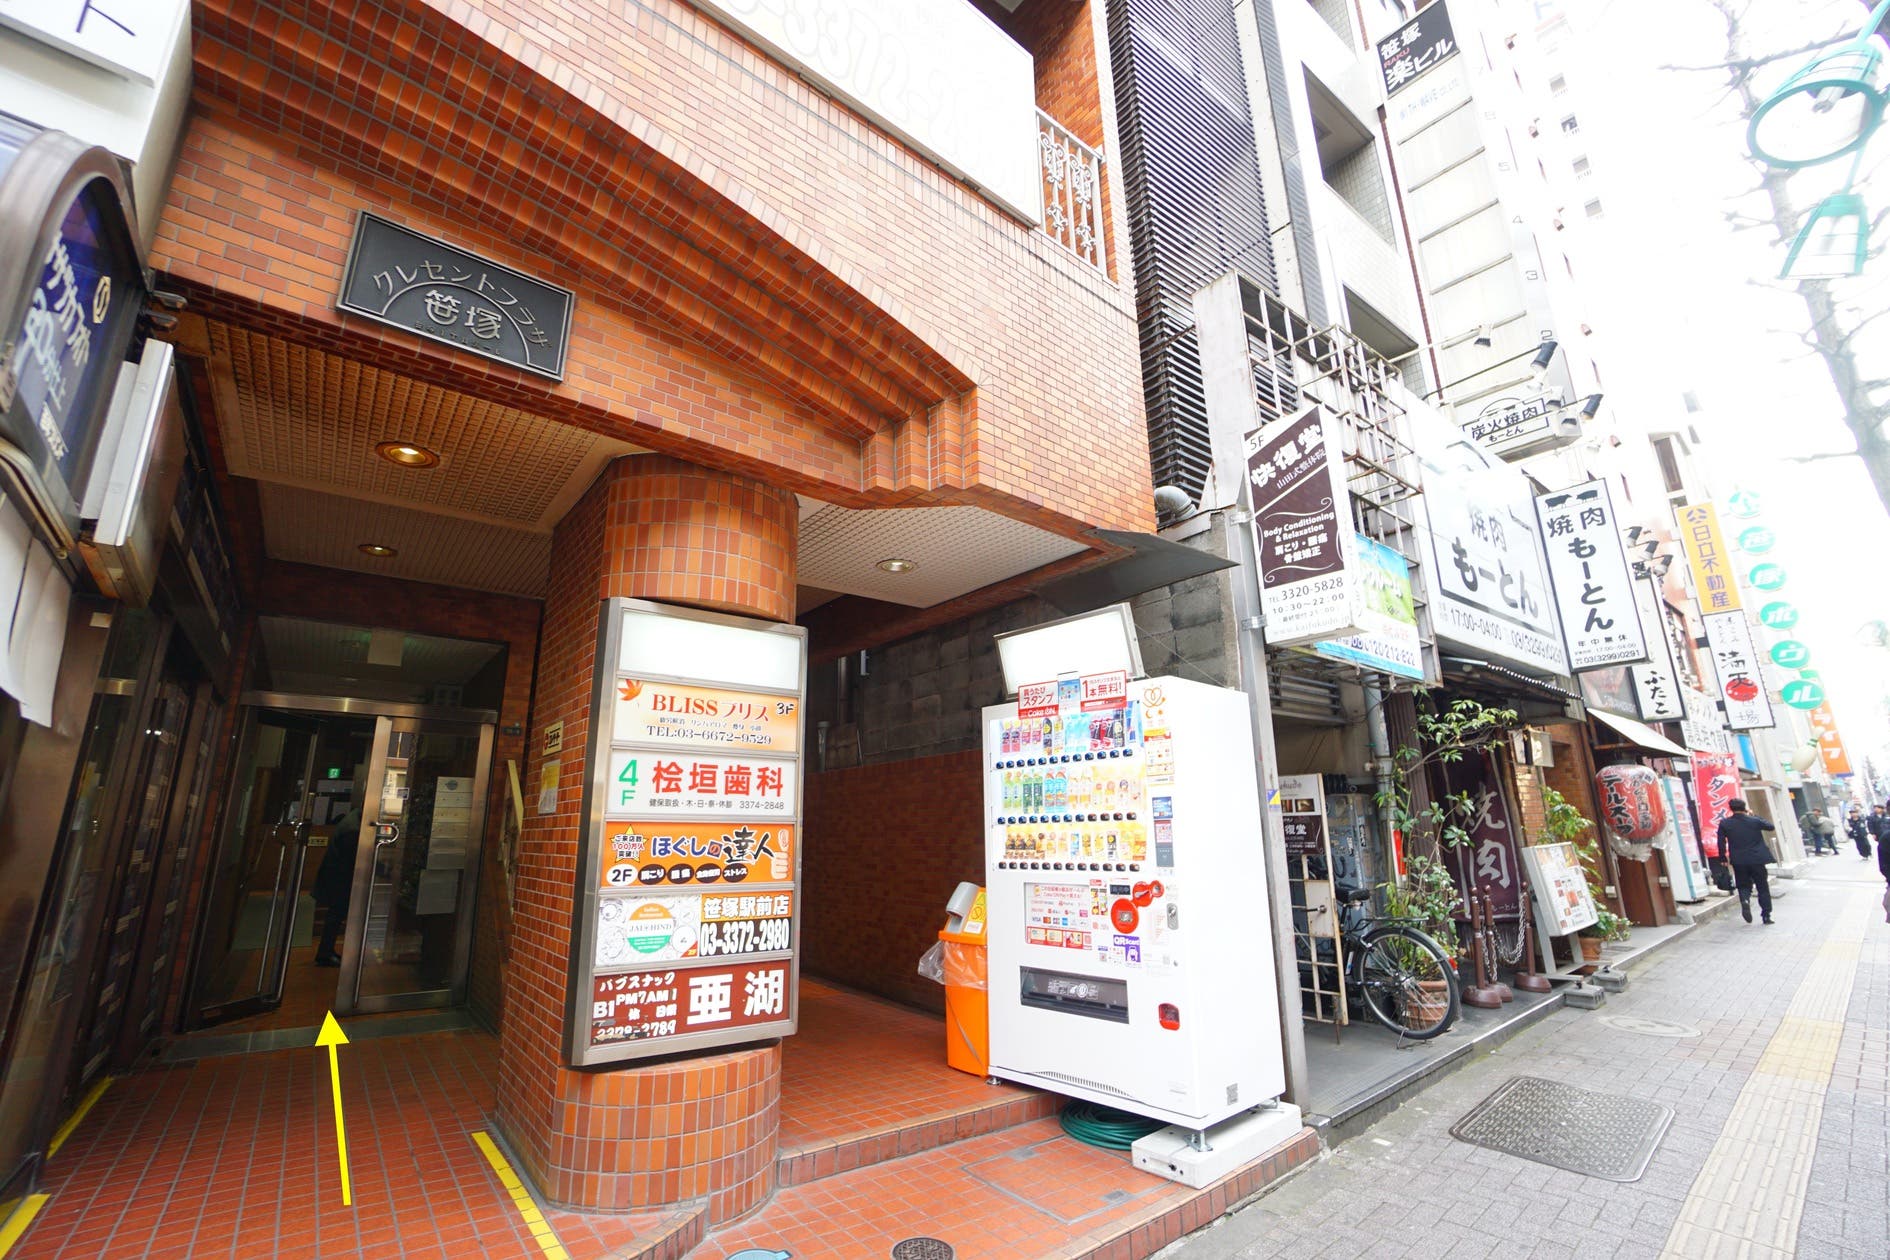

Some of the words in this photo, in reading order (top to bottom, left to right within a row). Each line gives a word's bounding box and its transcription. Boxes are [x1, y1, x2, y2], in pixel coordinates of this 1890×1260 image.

[1380, 21, 1422, 60] 笹塚
[1383, 47, 1411, 68] RAKU
[1385, 38, 1454, 90] 楽ビル
[1511, 215, 1524, 225] 4
[1525, 269, 1539, 281] 3
[372, 259, 553, 347] クレセントプラザ
[424, 289, 503, 340] 笹塚
[1540, 329, 1553, 341] 2
[1471, 406, 1538, 441] 炭火焼肉
[1488, 425, 1524, 443] もーとん
[1250, 435, 1265, 450] 5F
[1250, 423, 1324, 488] 快復堂
[1263, 526, 1283, 538] Body
[1283, 511, 1335, 532] Conditioning
[1275, 535, 1282, 543] &
[1282, 523, 1325, 541] Relaxation
[1470, 508, 1508, 553] 焼肉
[1547, 507, 1607, 538] 焼肉
[1281, 576, 1344, 601] 3320-5828
[1452, 536, 1539, 619] もーとん
[1568, 537, 1615, 633] もーとん
[652, 693, 719, 717] BLISS
[776, 702, 796, 716] 3F
[1023, 692, 1055, 707] スタンプ
[651, 760, 784, 798] 桧垣歯科
[739, 800, 785, 811] 3374-2848
[1603, 774, 1635, 835] テールスープ
[651, 825, 776, 866] ほぐしの達人
[611, 868, 633, 883] 2F
[723, 867, 748, 878] ストレス
[703, 895, 790, 920] 笹塚駅前店
[700, 918, 790, 957] 03-3372-2980
[599, 971, 676, 992] パブスナック
[592, 999, 616, 1019] B1
[686, 968, 785, 1026] 亜湖
